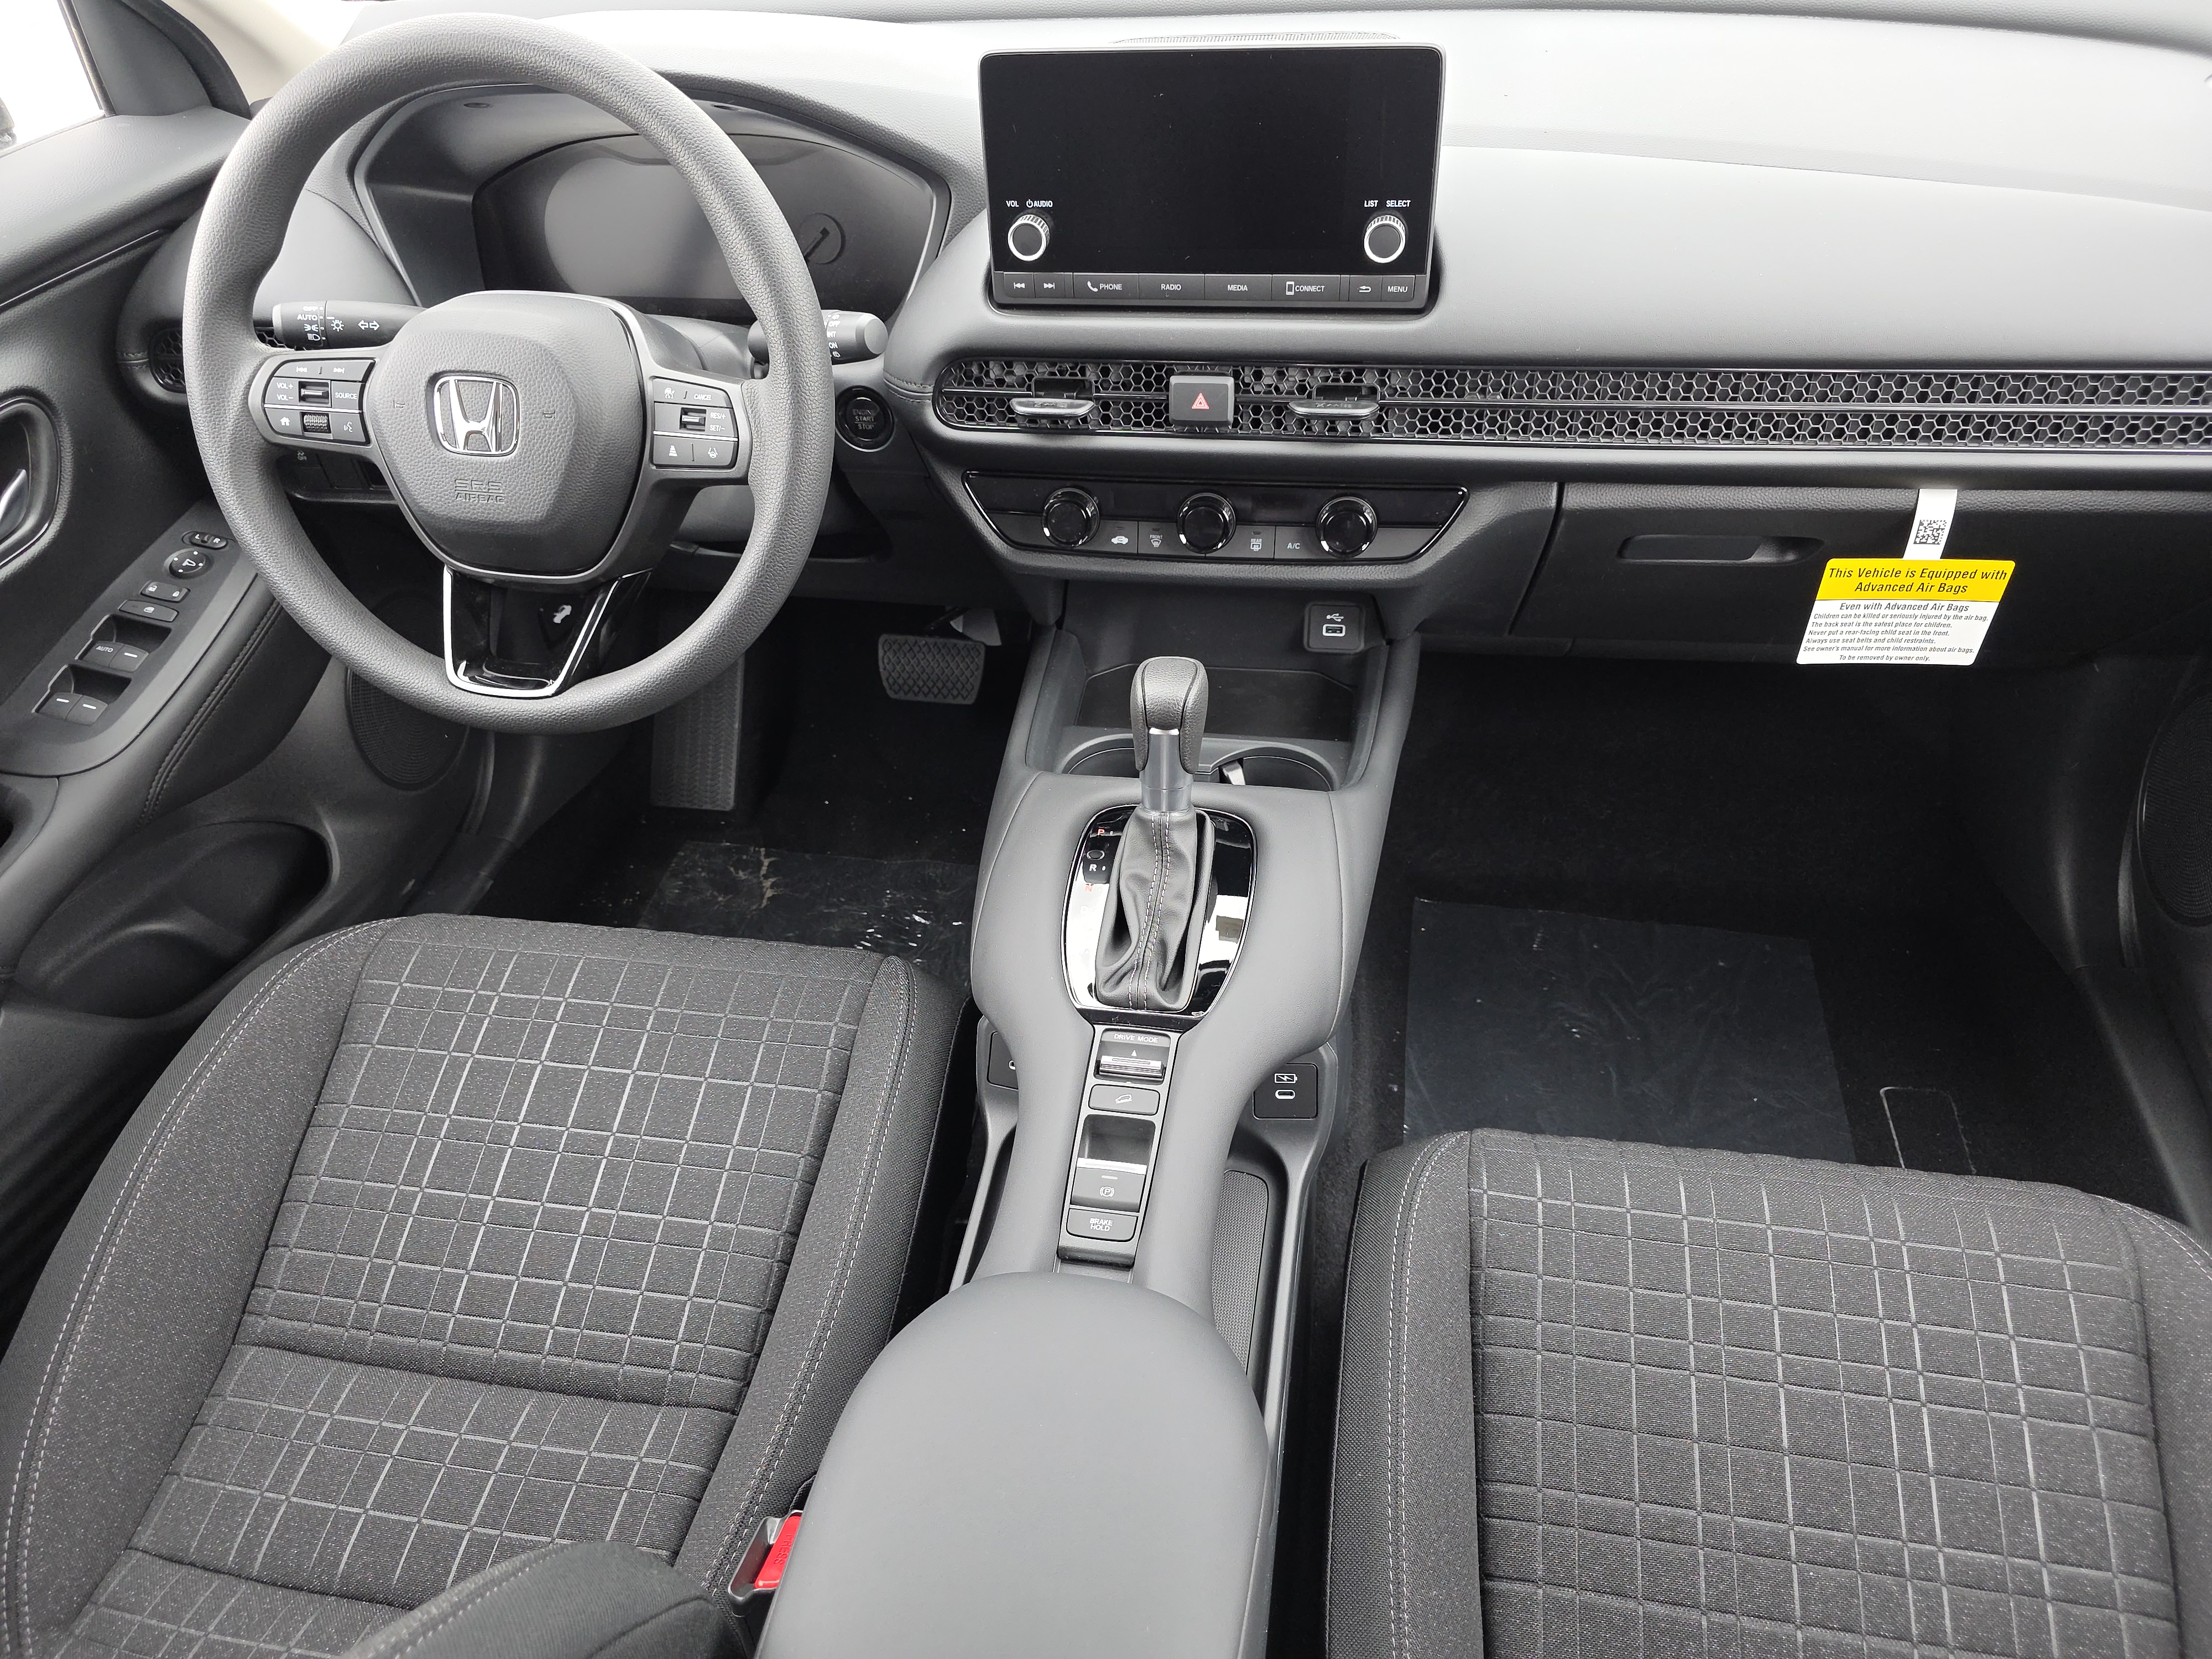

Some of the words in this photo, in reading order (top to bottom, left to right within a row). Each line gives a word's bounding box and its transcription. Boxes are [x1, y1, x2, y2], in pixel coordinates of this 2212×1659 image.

[455, 479, 502, 492] SRS
[455, 492, 505, 504] AIRBAG
[1829, 568, 1853, 578] This
[1858, 568, 1901, 578] Vehicle
[1905, 568, 1916, 577] is
[1919, 568, 1978, 580] Equipped
[1981, 570, 2007, 580] with
[1854, 582, 1914, 592] Advanced
[1916, 583, 1935, 592] Air
[1938, 583, 1968, 594] Bags
[1947, 603, 1969, 613] Bags
[1089, 1218, 1113, 1226] BRAKE
